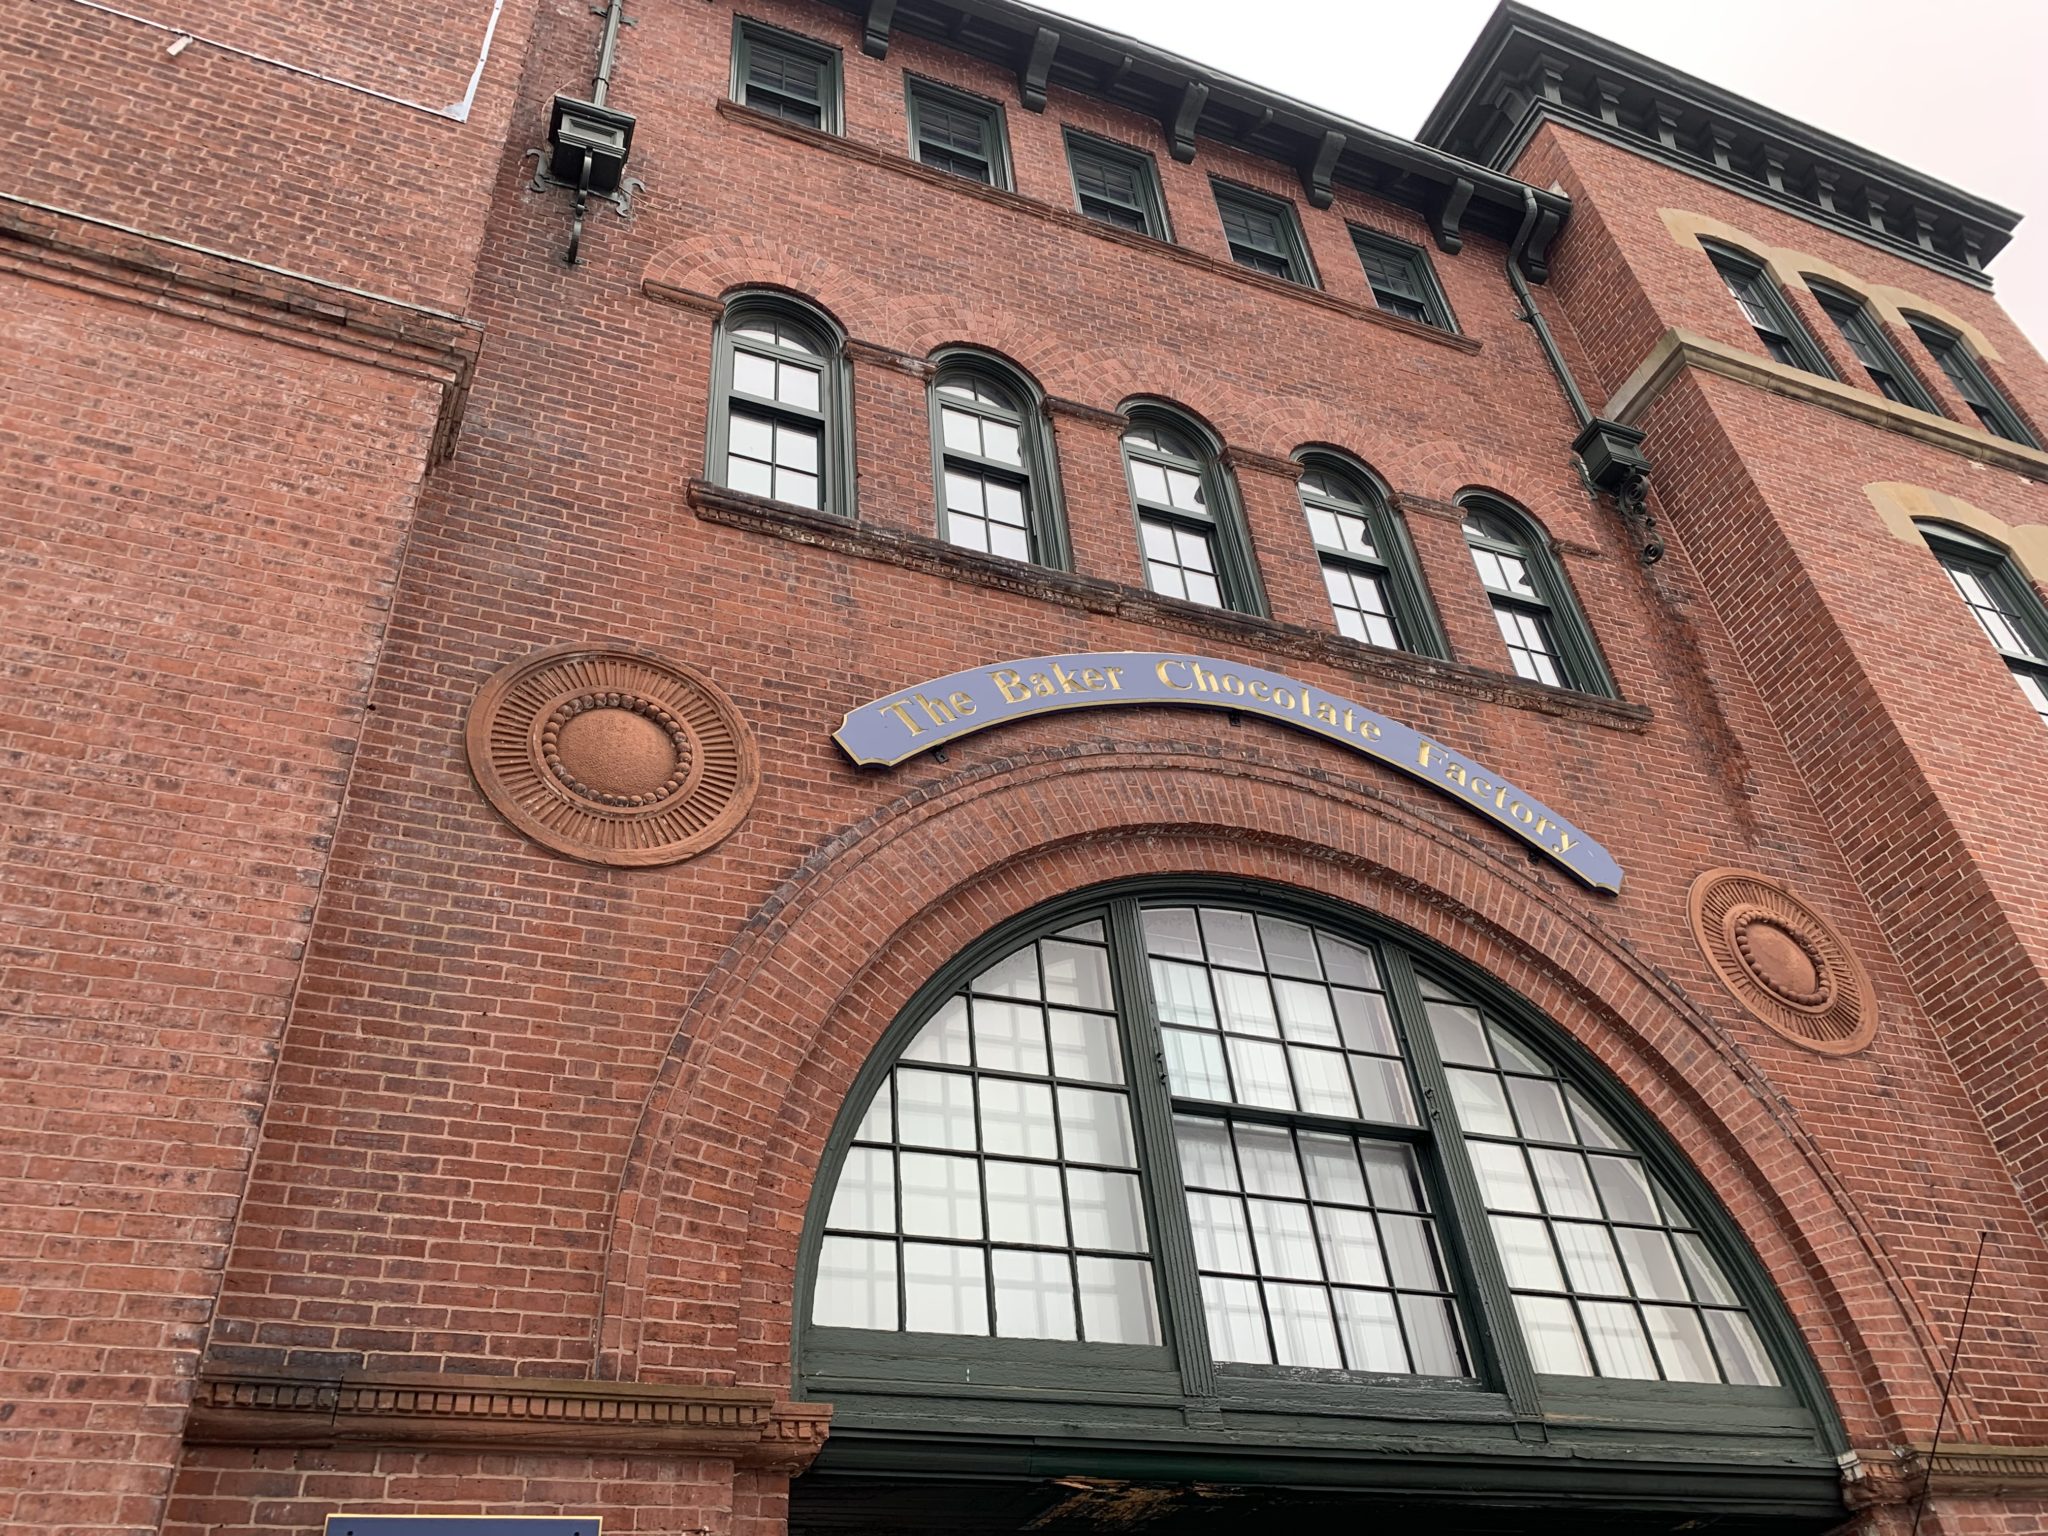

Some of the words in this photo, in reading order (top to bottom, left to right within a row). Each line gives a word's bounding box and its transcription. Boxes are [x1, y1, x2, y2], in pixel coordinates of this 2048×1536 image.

[879, 690, 977, 738] The
[989, 662, 1124, 703] Baker
[1156, 659, 1382, 742] Chocolate
[1415, 741, 1579, 853] Factory
